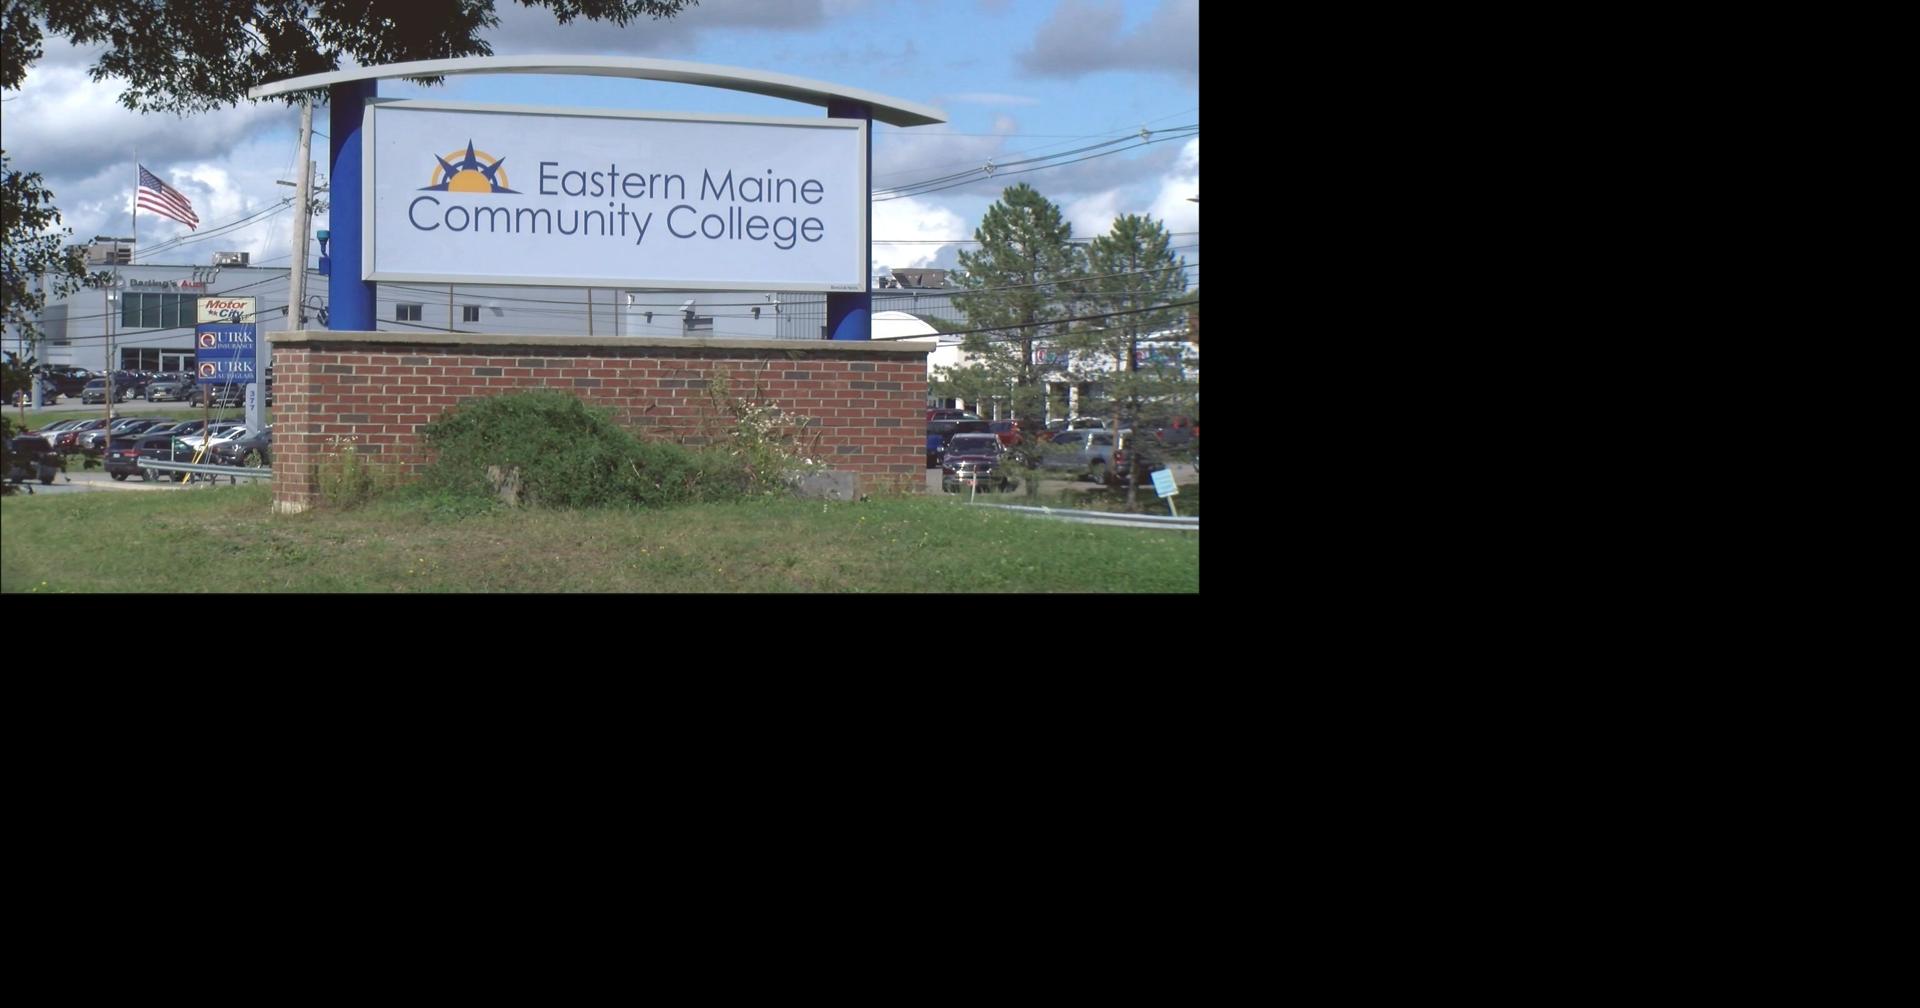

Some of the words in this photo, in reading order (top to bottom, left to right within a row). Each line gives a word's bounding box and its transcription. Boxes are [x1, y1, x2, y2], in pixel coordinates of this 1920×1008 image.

[539, 161, 685, 199] Eastern
[700, 167, 825, 205] Maine
[408, 195, 653, 246] Community
[666, 204, 825, 251] College
[130, 279, 177, 288] Darling's
[206, 301, 248, 309] Motor
[219, 309, 245, 319] City
